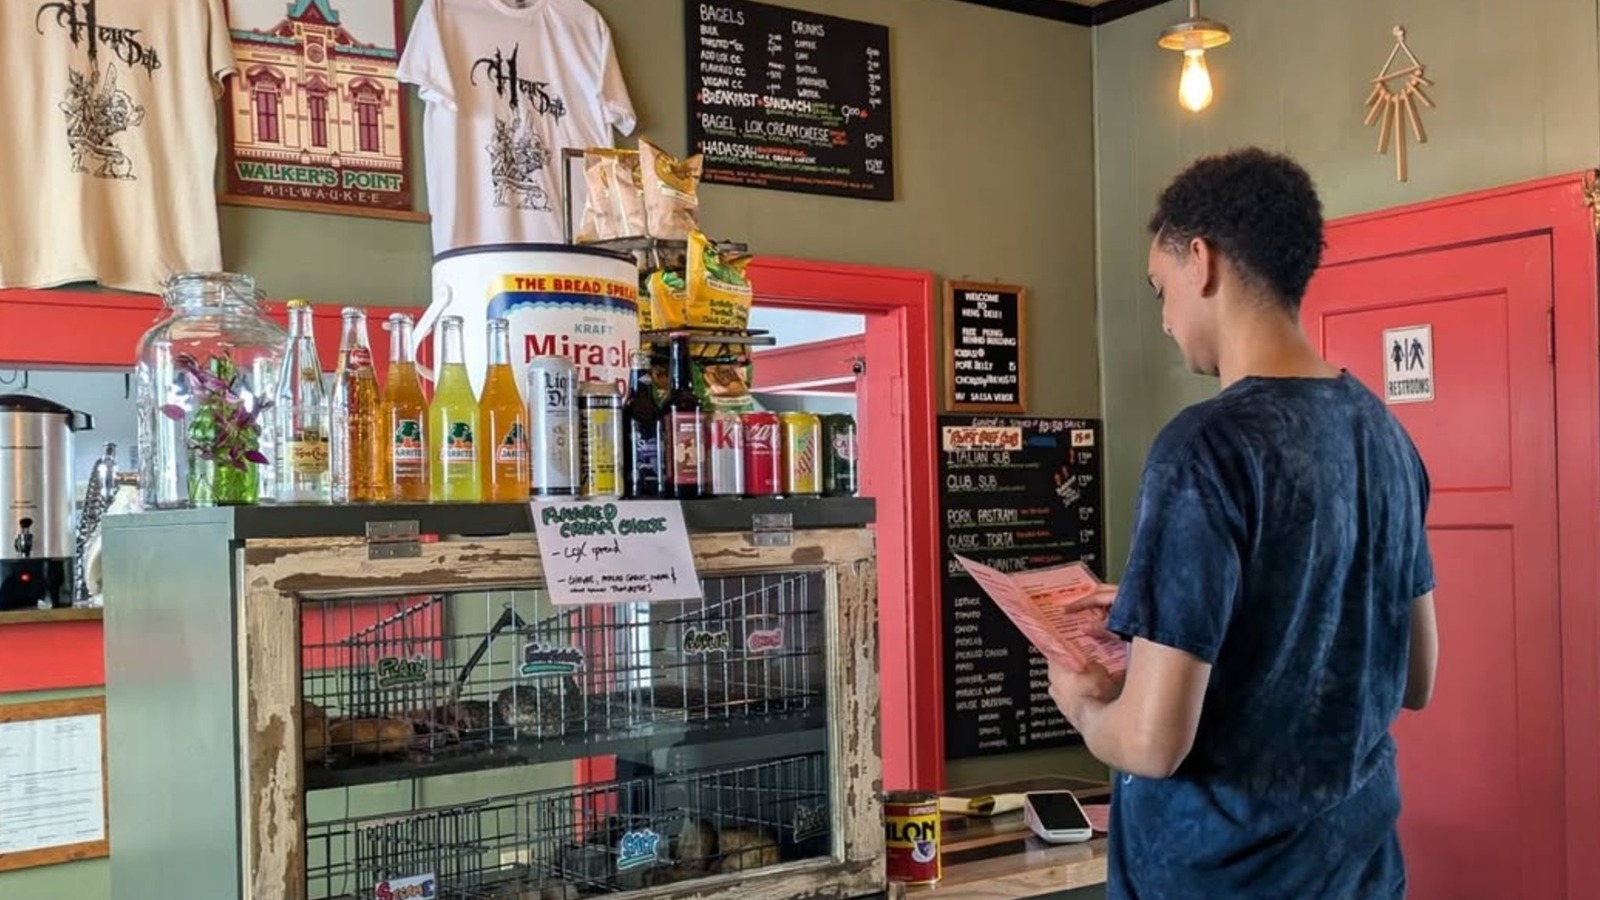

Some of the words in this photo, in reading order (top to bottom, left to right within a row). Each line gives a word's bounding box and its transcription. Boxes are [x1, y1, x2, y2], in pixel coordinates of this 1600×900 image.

[699, 3, 746, 27] BAGELS
[791, 20, 826, 38] DRINKS
[702, 87, 759, 108] BREAKFAST
[762, 94, 812, 114] SANDWICH
[766, 122, 799, 140] CREAM
[799, 126, 831, 143] CHEESE
[702, 140, 758, 159] HADASSAH
[236, 161, 338, 187] WALKER'S
[343, 171, 403, 193] POINT
[515, 277, 546, 291] THE
[553, 278, 601, 293] BREAD
[965, 293, 1000, 303] WELCOME
[977, 302, 988, 310] TO
[574, 323, 613, 334] KRAFT
[523, 334, 633, 368] Miracl
[955, 360, 973, 370] PORK
[1388, 377, 1430, 396] RESTROOMS
[970, 392, 993, 402] SALSA
[947, 451, 989, 466] ITALIAN
[992, 451, 1011, 464] SUB
[946, 474, 972, 489] CLUB
[978, 474, 998, 488] SUB
[541, 502, 618, 527] FLAVORED
[947, 508, 972, 525] PORK
[977, 508, 1019, 524] PASTRAMI
[559, 521, 616, 539] CREAM
[618, 516, 669, 536] CHEESE
[986, 532, 1015, 548] TORTA
[378, 655, 429, 680] PLAIN
